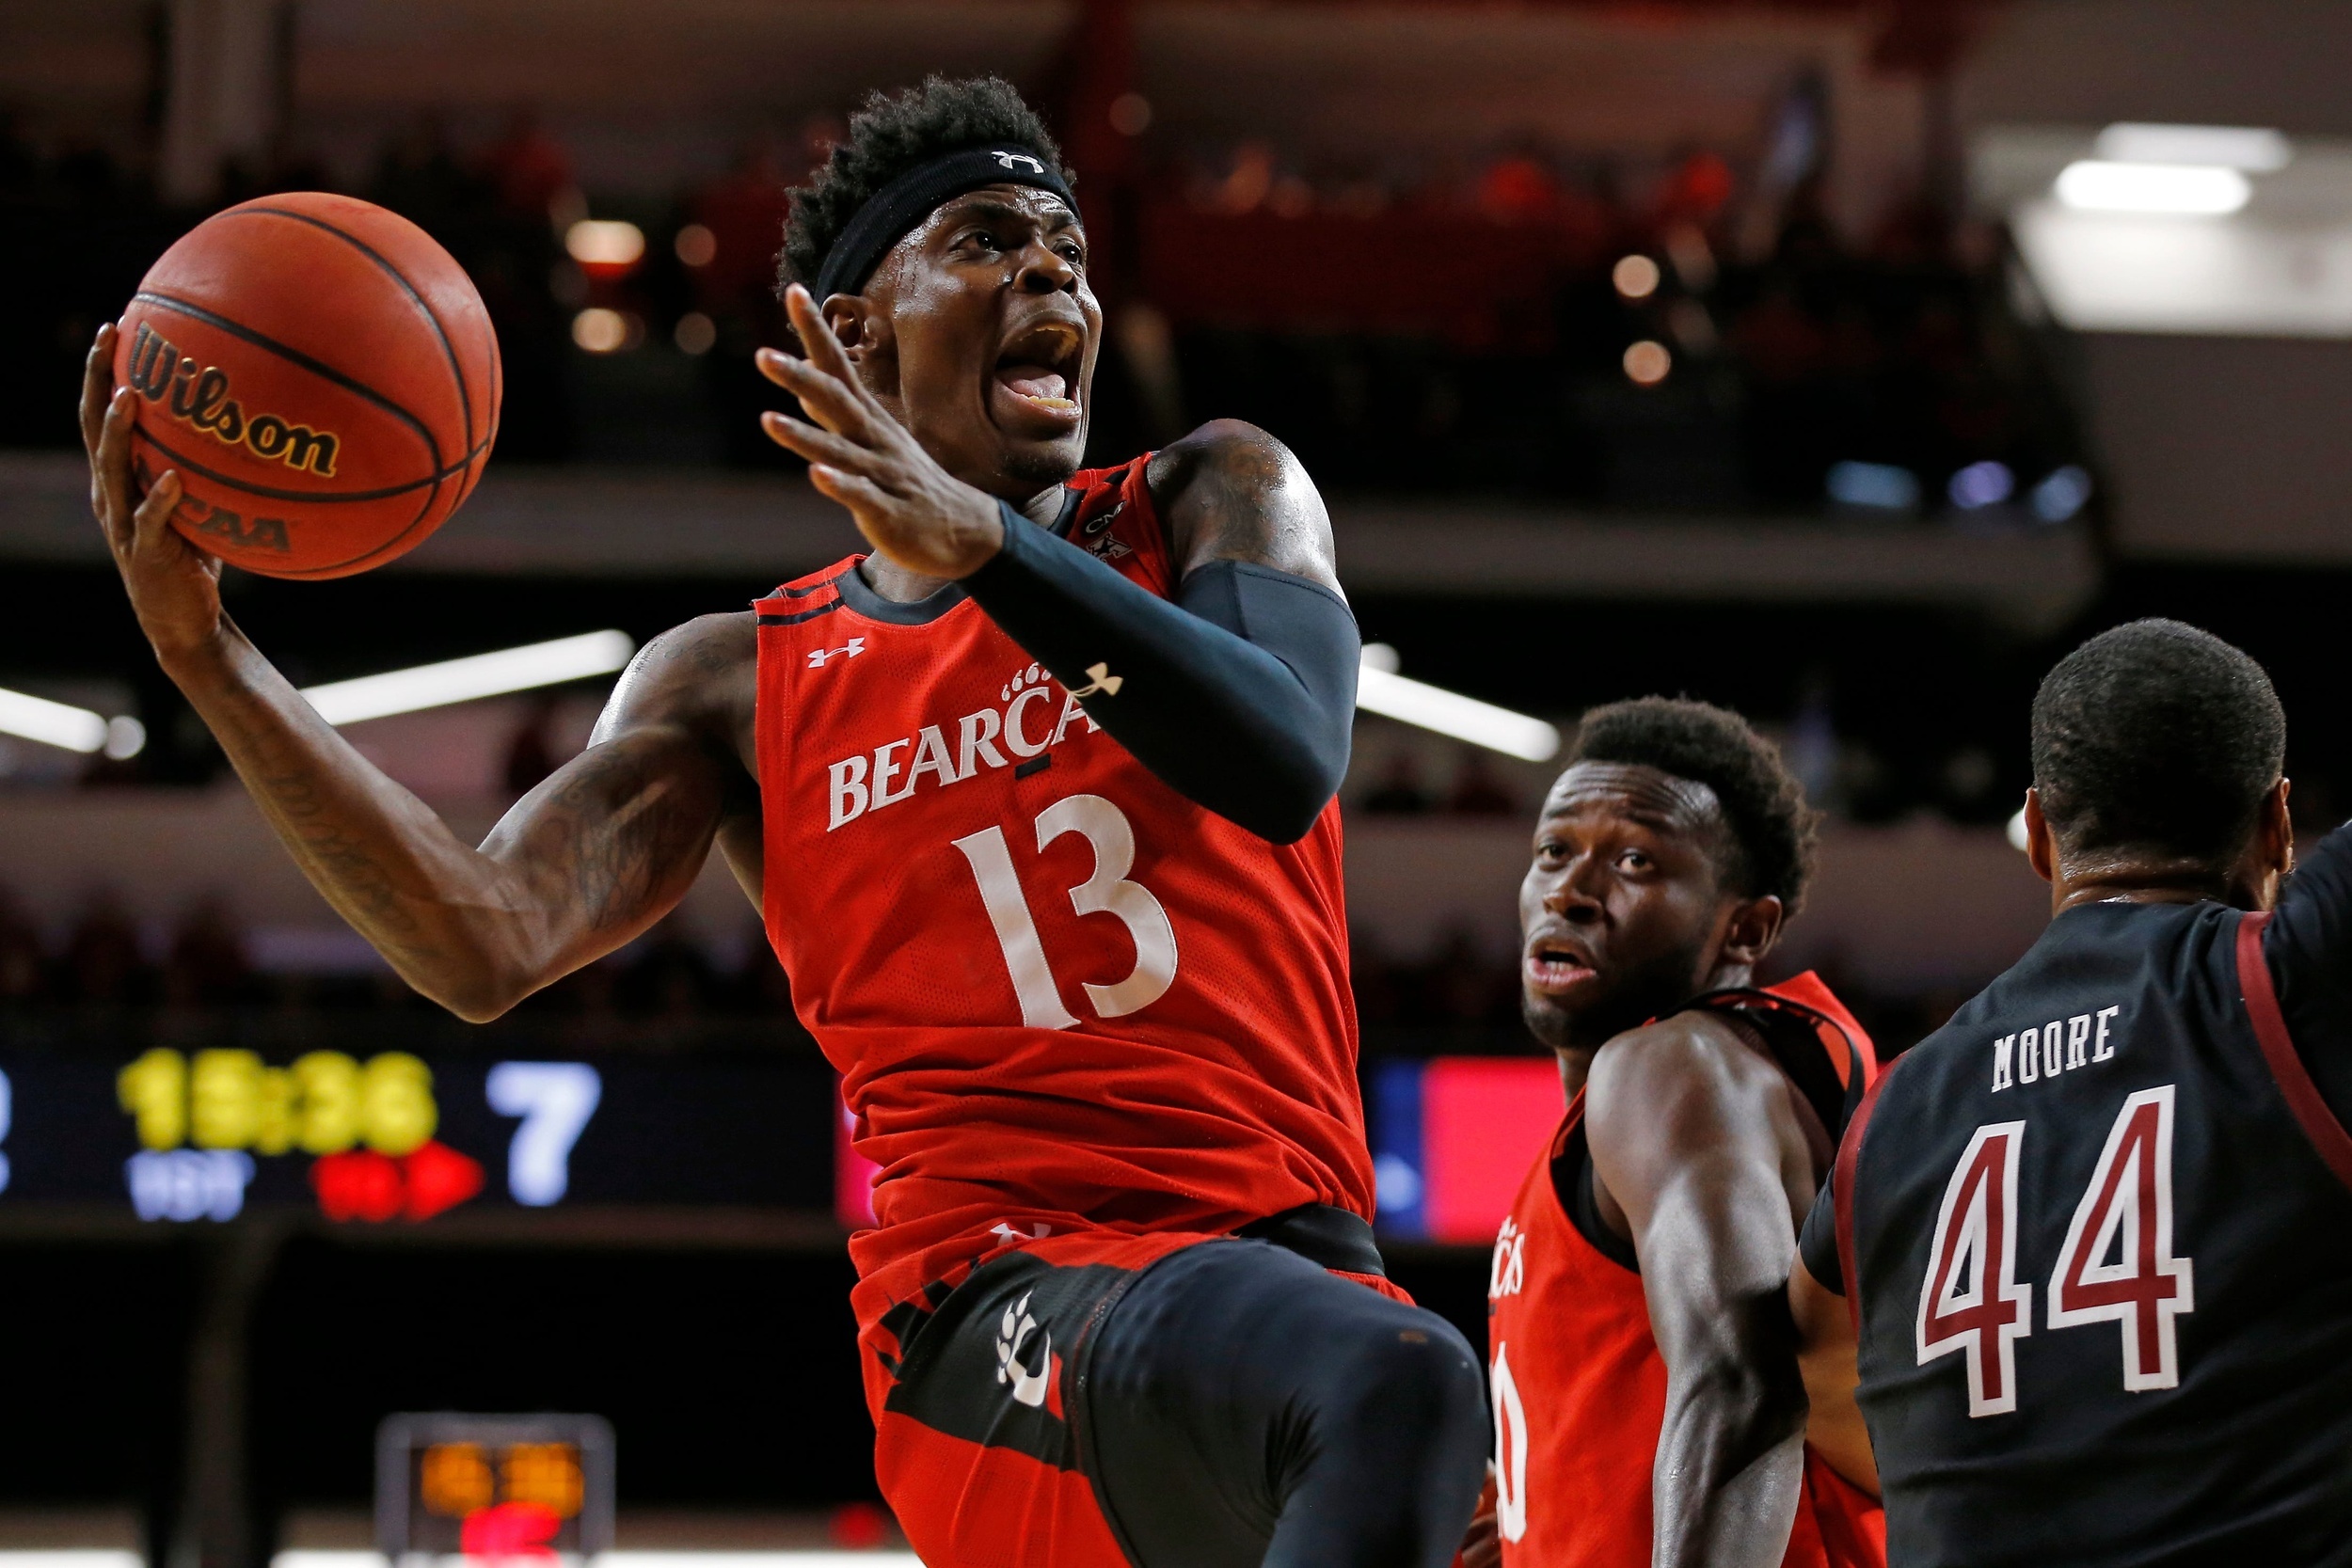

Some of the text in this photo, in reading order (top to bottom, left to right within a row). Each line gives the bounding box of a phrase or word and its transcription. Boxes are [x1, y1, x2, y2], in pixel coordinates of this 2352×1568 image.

[128, 321, 340, 477] Wilson
[827, 685, 1102, 832] BEARCA
[951, 794, 1178, 1030] 13
[1992, 1005, 2119, 1093] MOORE
[485, 1061, 602, 1207] 7
[1916, 1084, 2194, 1418] 44
